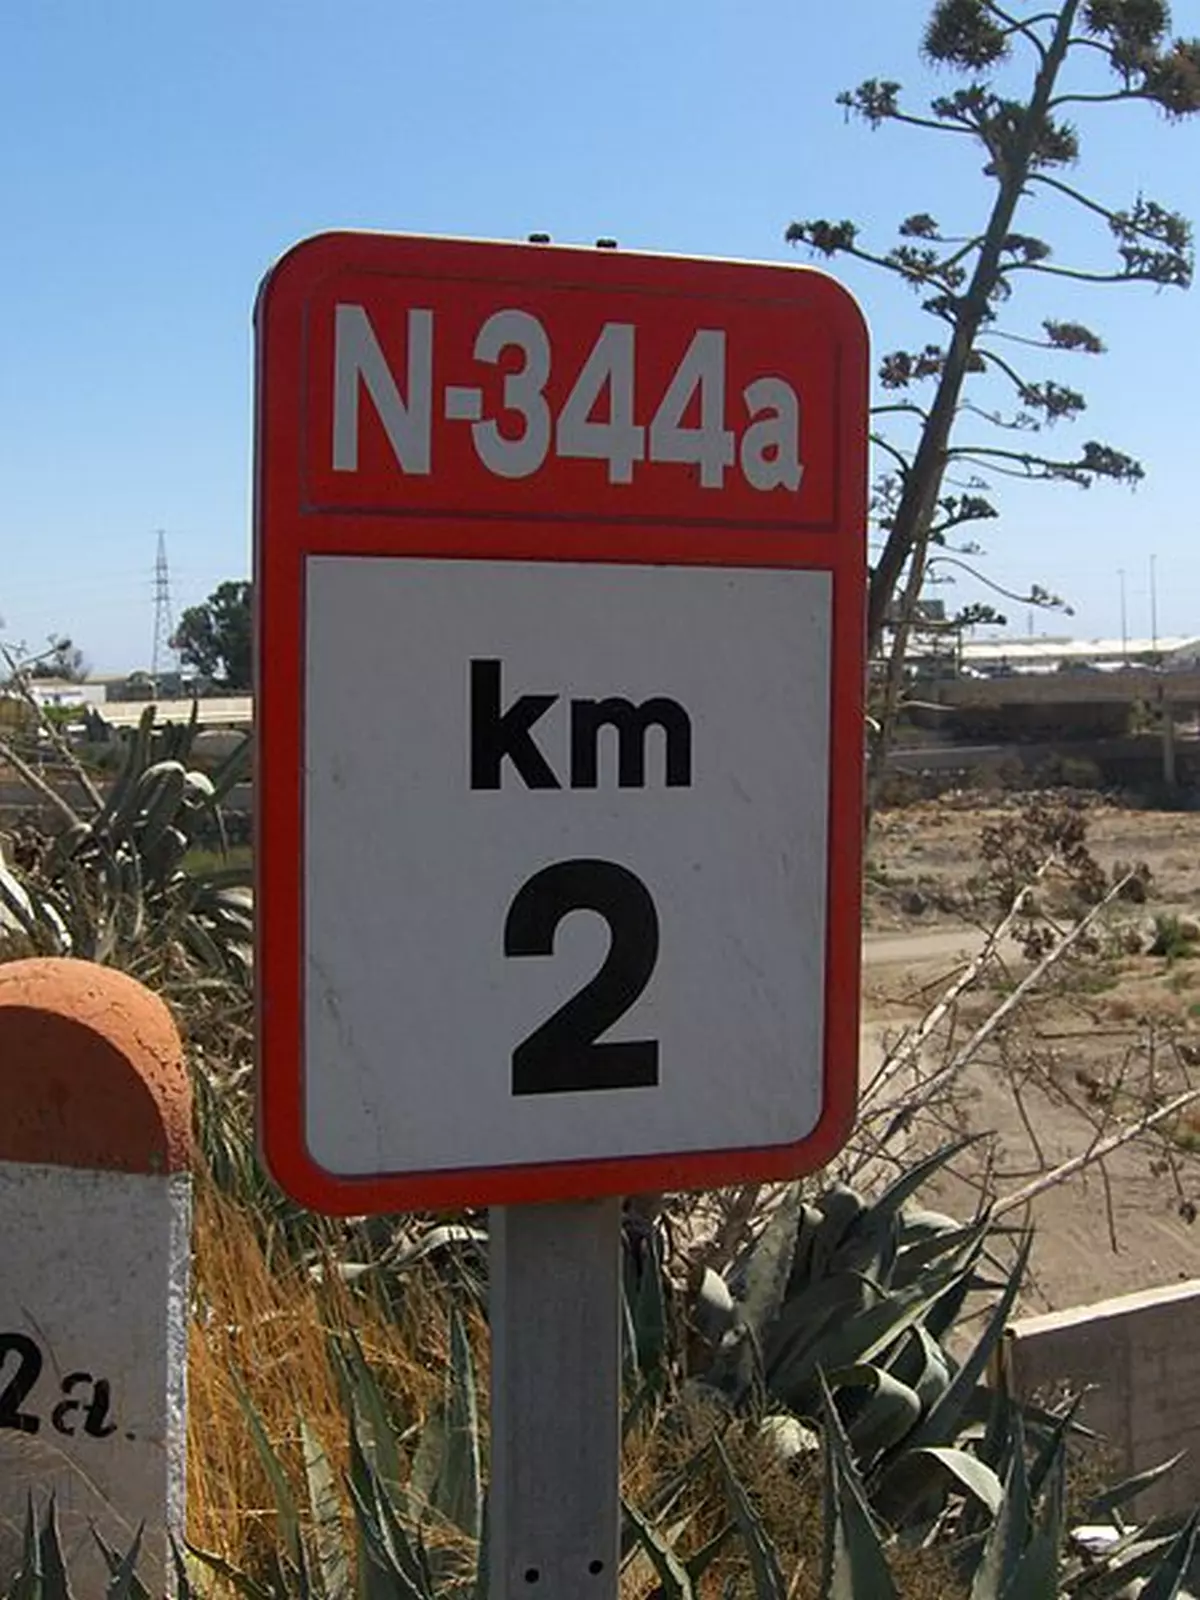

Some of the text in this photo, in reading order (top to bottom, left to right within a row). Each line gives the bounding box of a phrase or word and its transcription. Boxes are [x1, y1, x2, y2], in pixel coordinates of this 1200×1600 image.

[332, 303, 804, 492] N-344a
[469, 658, 692, 790] km
[503, 857, 660, 1097] 2
